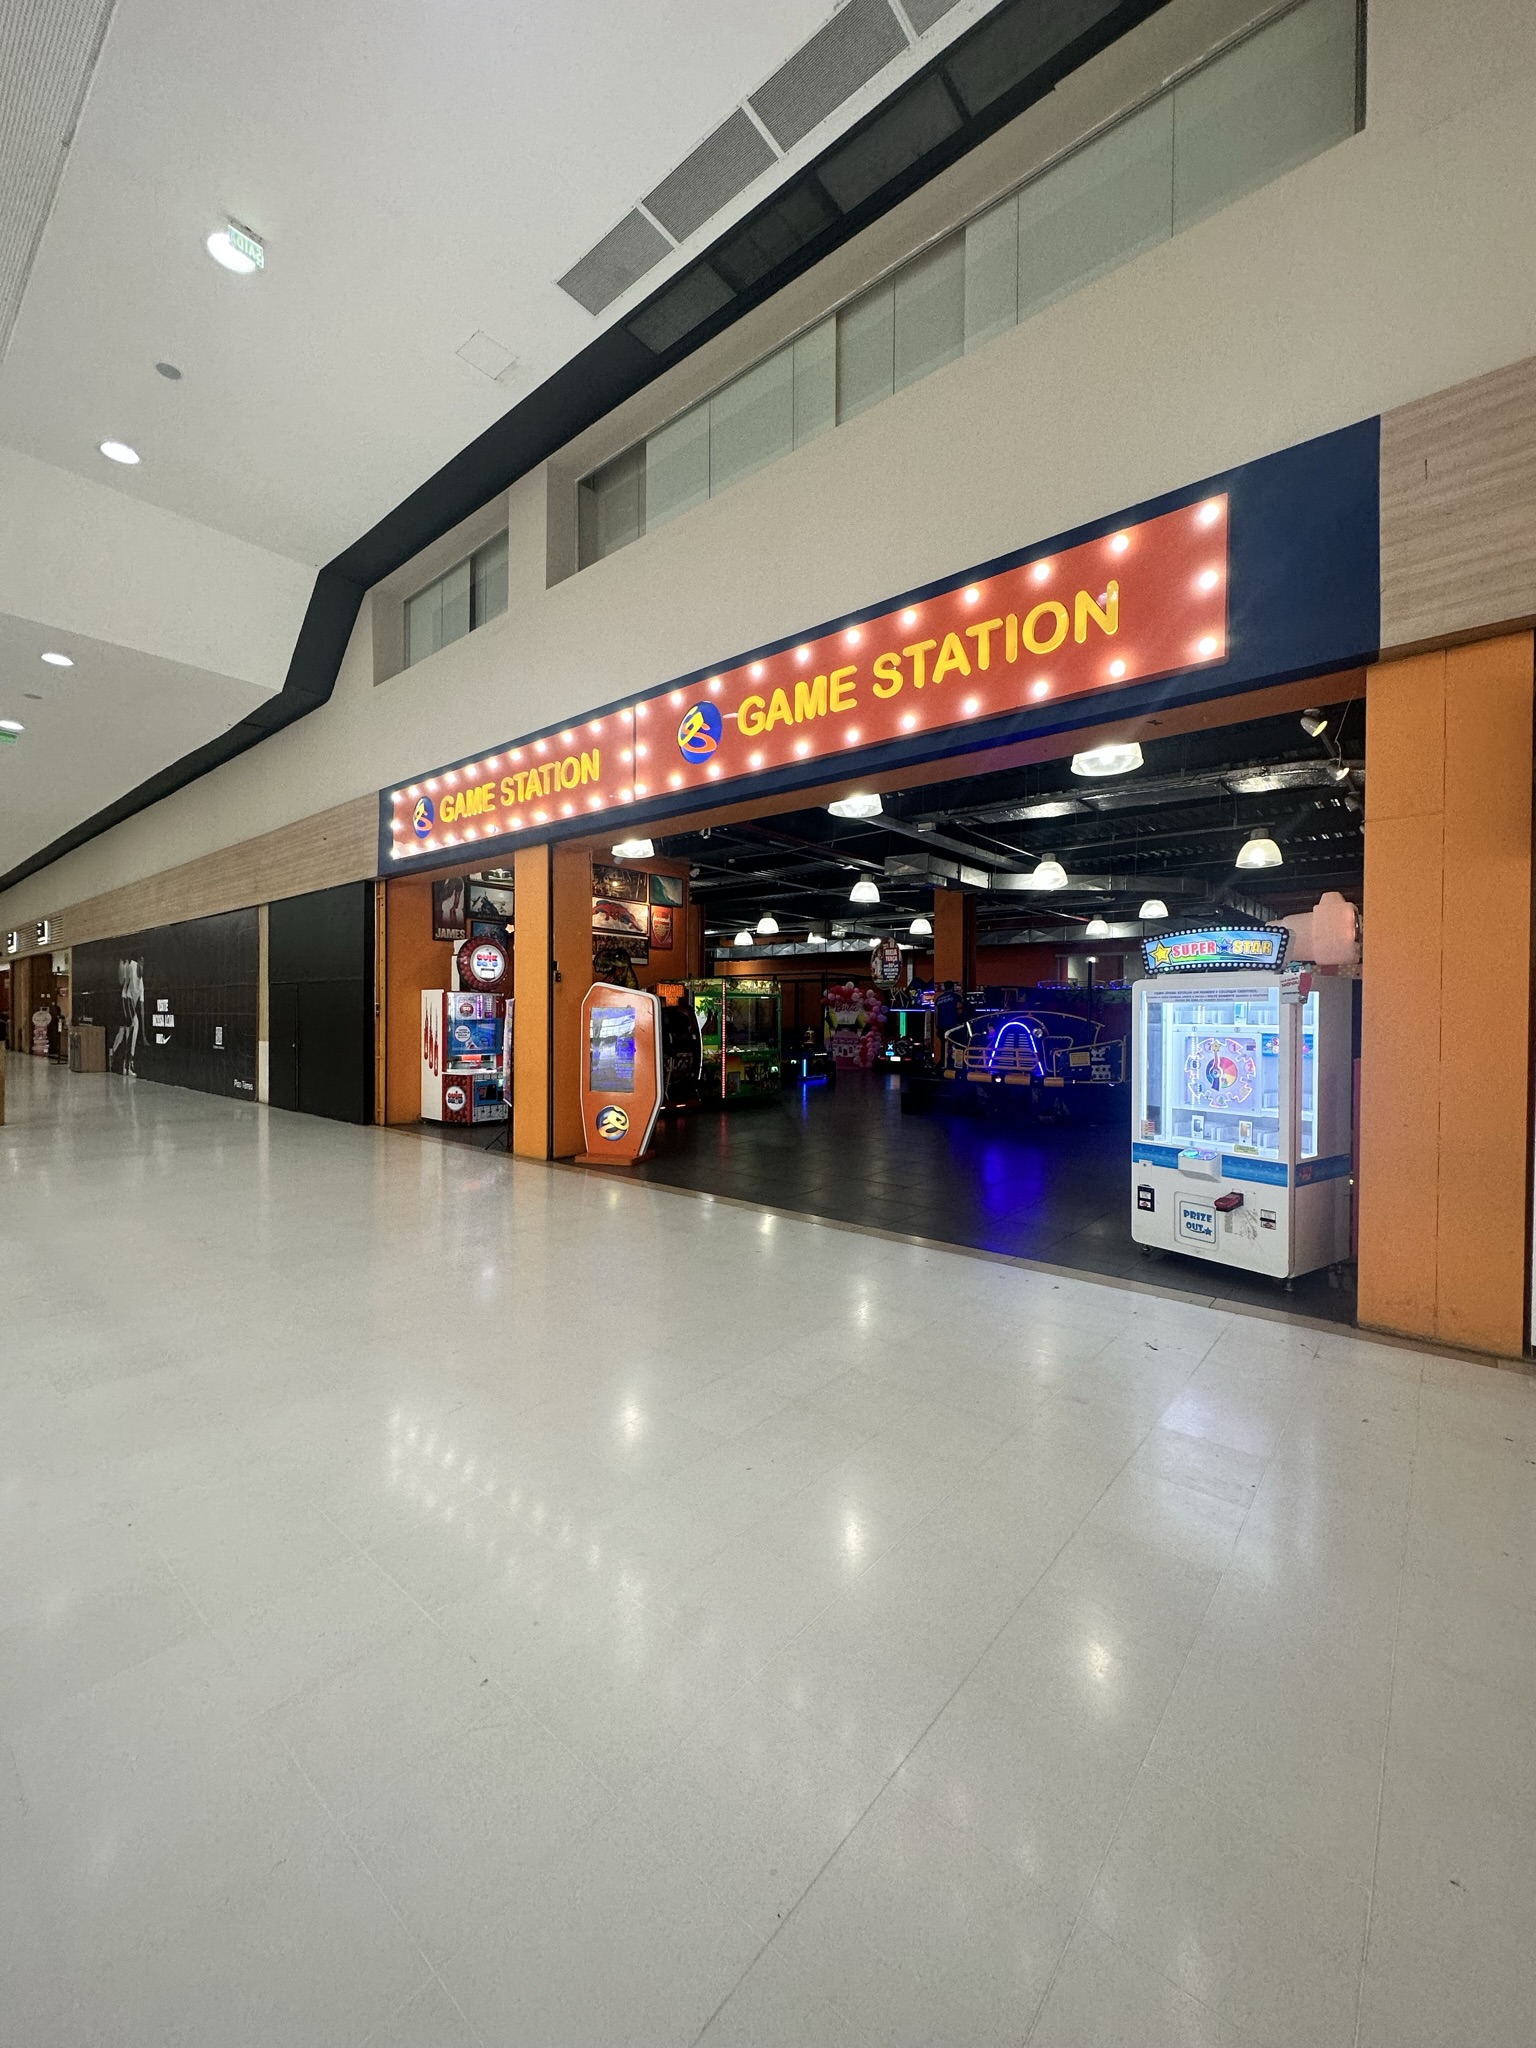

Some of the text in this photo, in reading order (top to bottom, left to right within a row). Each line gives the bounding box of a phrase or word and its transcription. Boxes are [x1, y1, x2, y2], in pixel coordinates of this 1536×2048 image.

[736, 579, 1121, 737] GAME STATION
[439, 748, 601, 824] GAME STATION
[434, 927, 466, 939] JAMES
[1171, 938, 1274, 958] SUPER STAR
[1183, 1209, 1213, 1224] PRIZE
[1185, 1221, 1204, 1231] OUT
